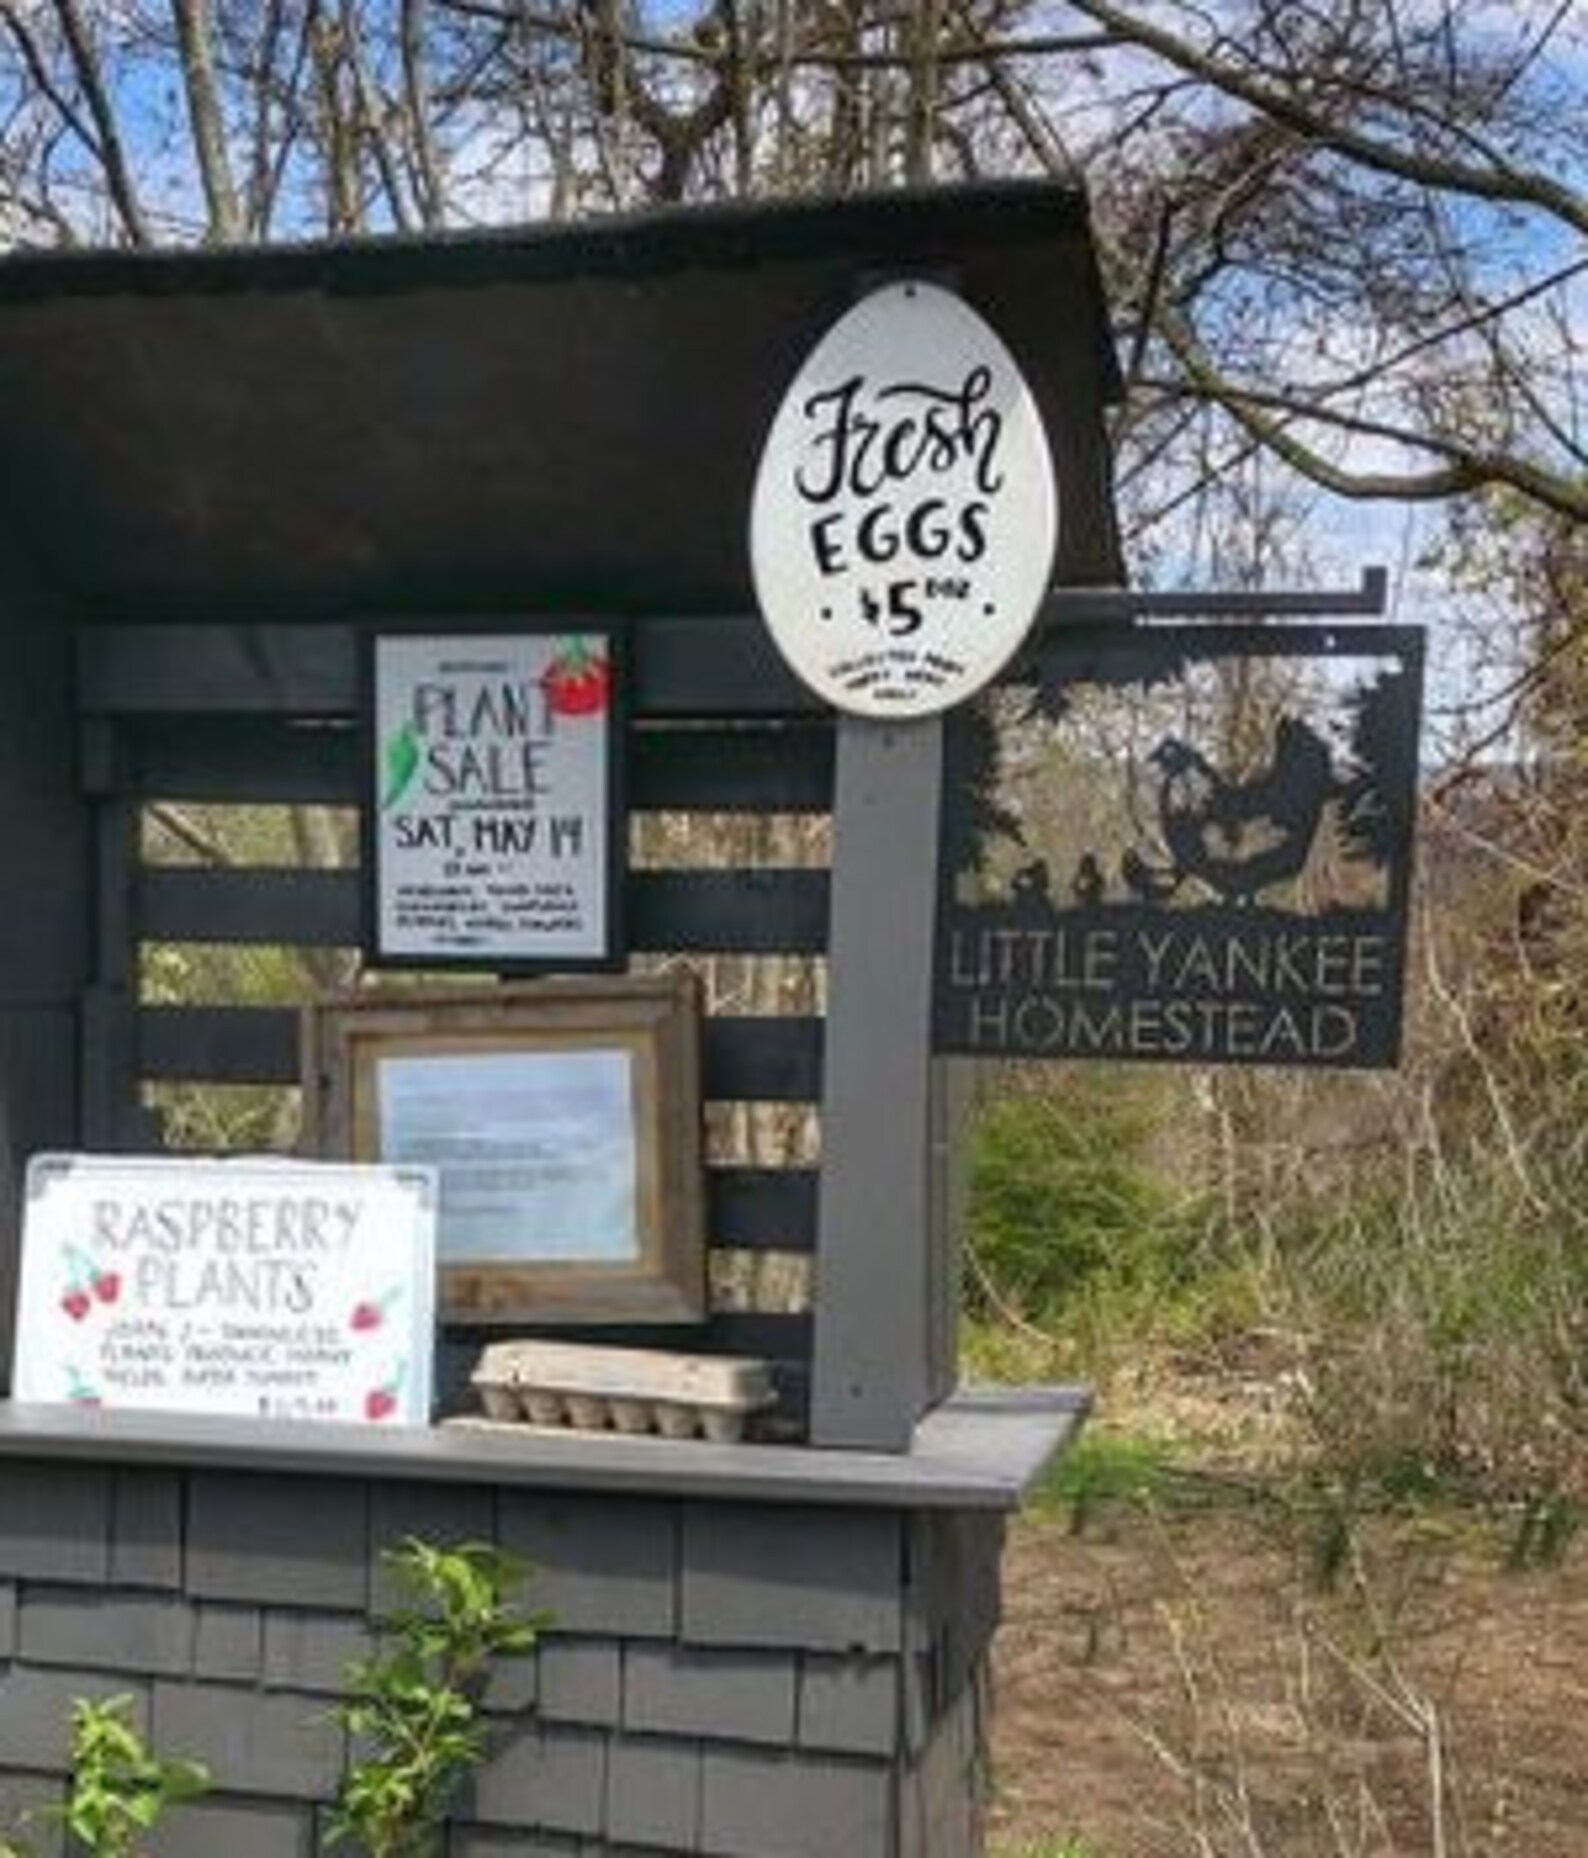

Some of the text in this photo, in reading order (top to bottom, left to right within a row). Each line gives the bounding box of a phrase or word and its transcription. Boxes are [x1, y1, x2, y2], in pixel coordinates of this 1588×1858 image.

[795, 365, 1004, 502] Fresh
[810, 498, 989, 576] EGGS
[860, 581, 922, 637] $5
[413, 682, 555, 738] PLANT
[424, 740, 552, 796] SALE
[473, 815, 536, 855] MAY
[551, 815, 583, 858] 14
[950, 930, 1385, 996] LITTLE YANKEE
[970, 997, 1359, 1057] HOMESTEAD
[92, 1199, 362, 1255] RASPBERRY
[135, 1254, 319, 1315] PLANTS
